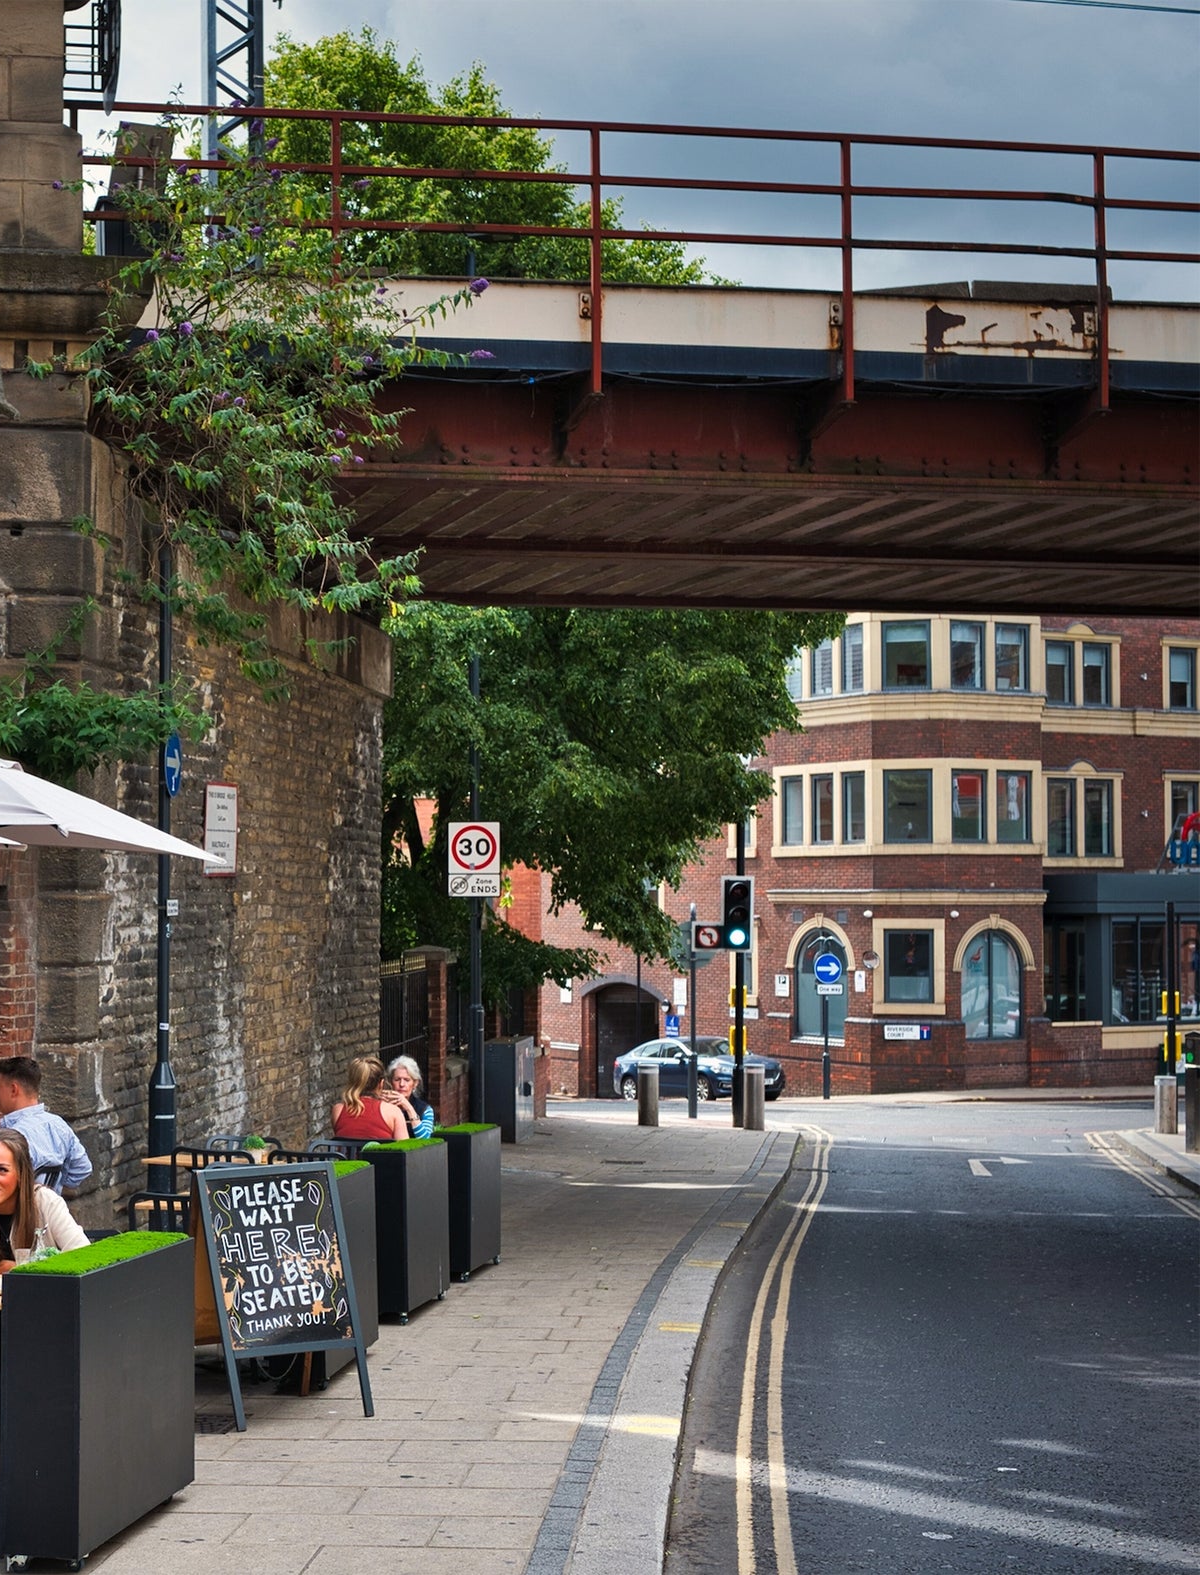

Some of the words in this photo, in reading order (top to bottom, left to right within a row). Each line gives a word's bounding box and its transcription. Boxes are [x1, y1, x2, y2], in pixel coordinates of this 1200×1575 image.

[459, 838, 490, 856] 30
[231, 1179, 304, 1208] PLEASE
[239, 1203, 295, 1227] WAIT
[221, 1224, 320, 1263] HERE
[247, 1264, 274, 1287] TO
[282, 1258, 313, 1284] BE
[241, 1281, 325, 1315] SEATED
[246, 1313, 294, 1334] THANK
[297, 1311, 326, 1327] YOU!
